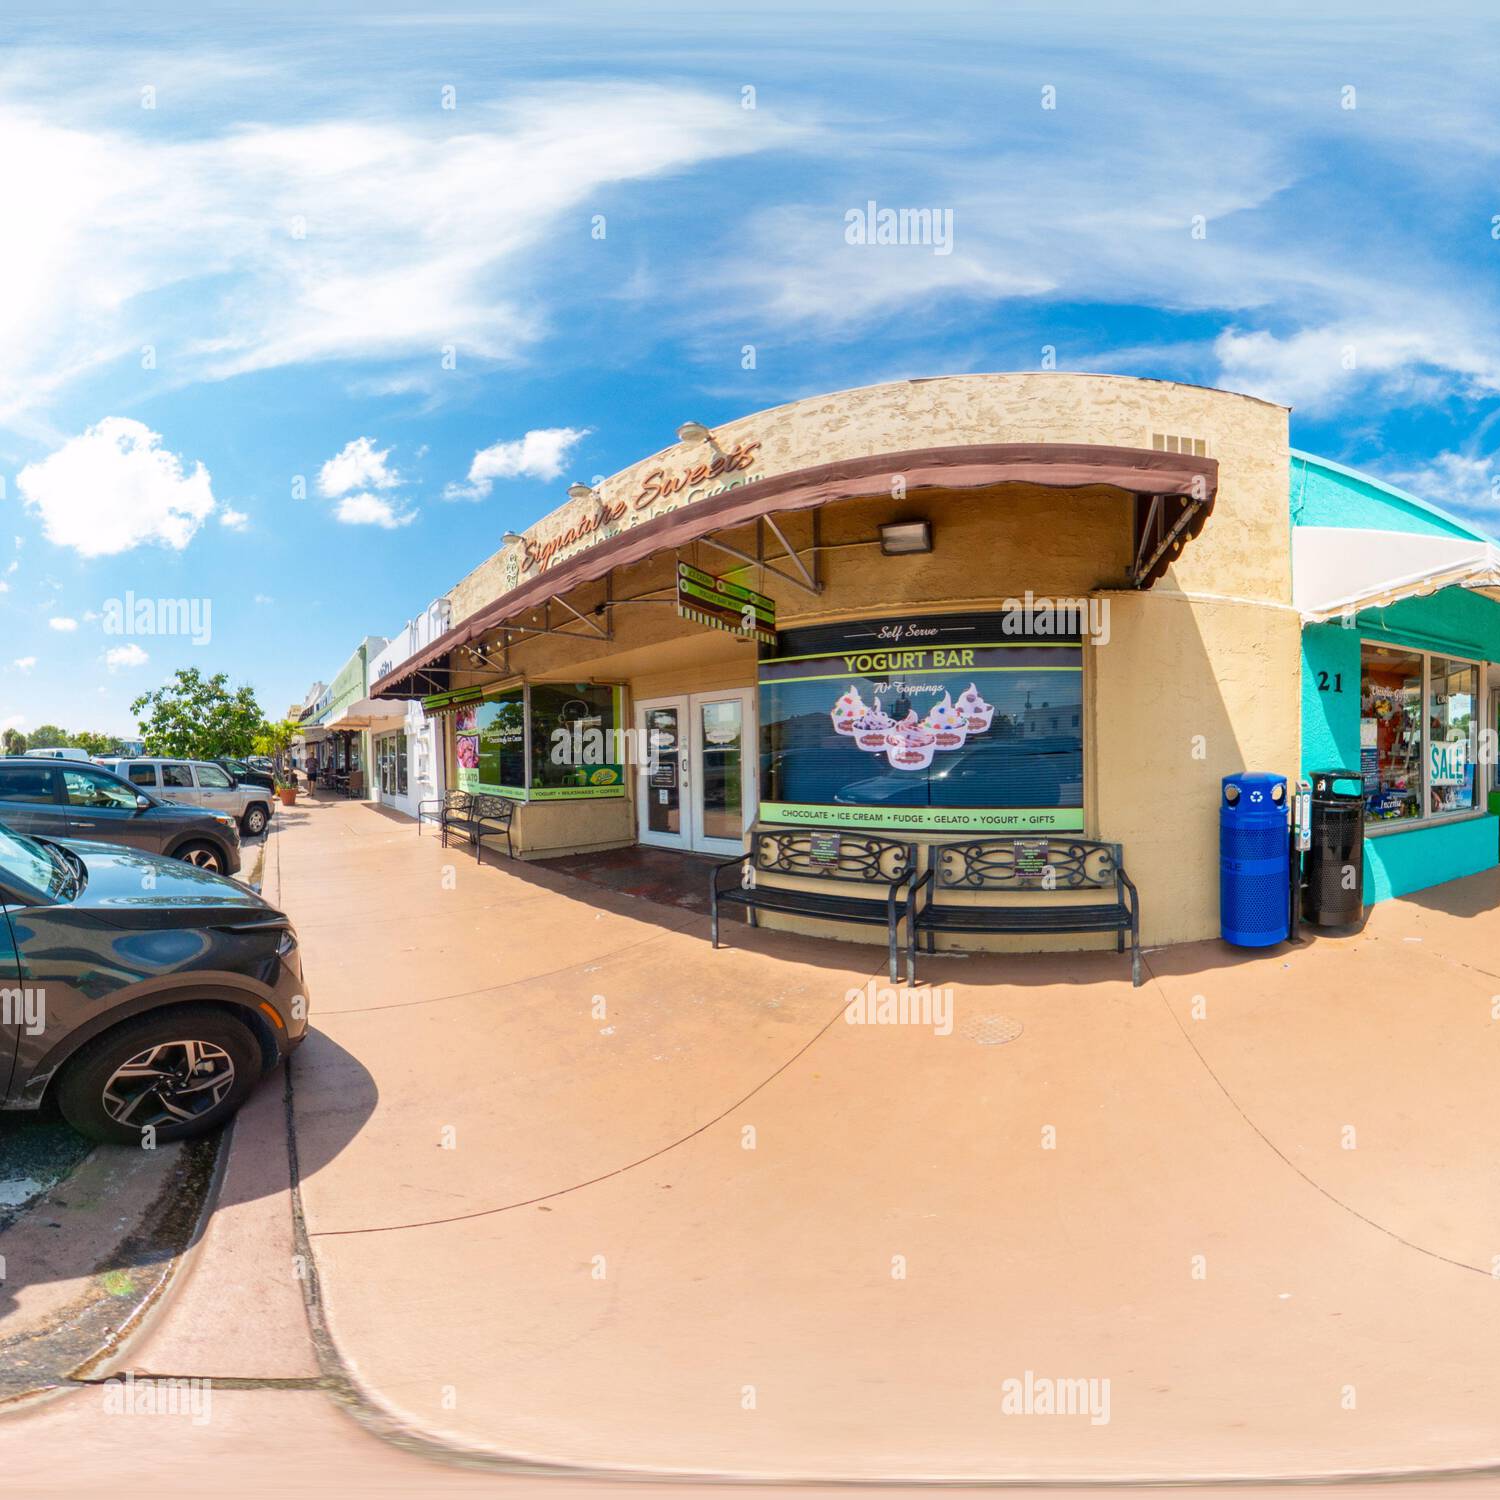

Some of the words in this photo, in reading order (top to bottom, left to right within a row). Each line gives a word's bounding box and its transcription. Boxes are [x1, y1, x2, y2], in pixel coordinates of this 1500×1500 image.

[521, 501, 627, 573] Signature
[634, 442, 761, 511] Sweets
[878, 626, 902, 641] Self
[905, 624, 938, 637] Serve
[843, 651, 926, 672] YOGURT
[933, 650, 975, 667] BAR
[893, 681, 944, 696] Toppings
[1317, 671, 1343, 693] 21
[1431, 746, 1464, 780] SALE
[782, 809, 828, 820] CHOCOLATE
[837, 812, 851, 820] ICE
[852, 812, 883, 821] CREAM
[893, 814, 923, 823] FUDGE
[934, 815, 970, 824] GELATO
[980, 815, 1018, 824] YOGURT
[1029, 815, 1055, 824] GIFTS
